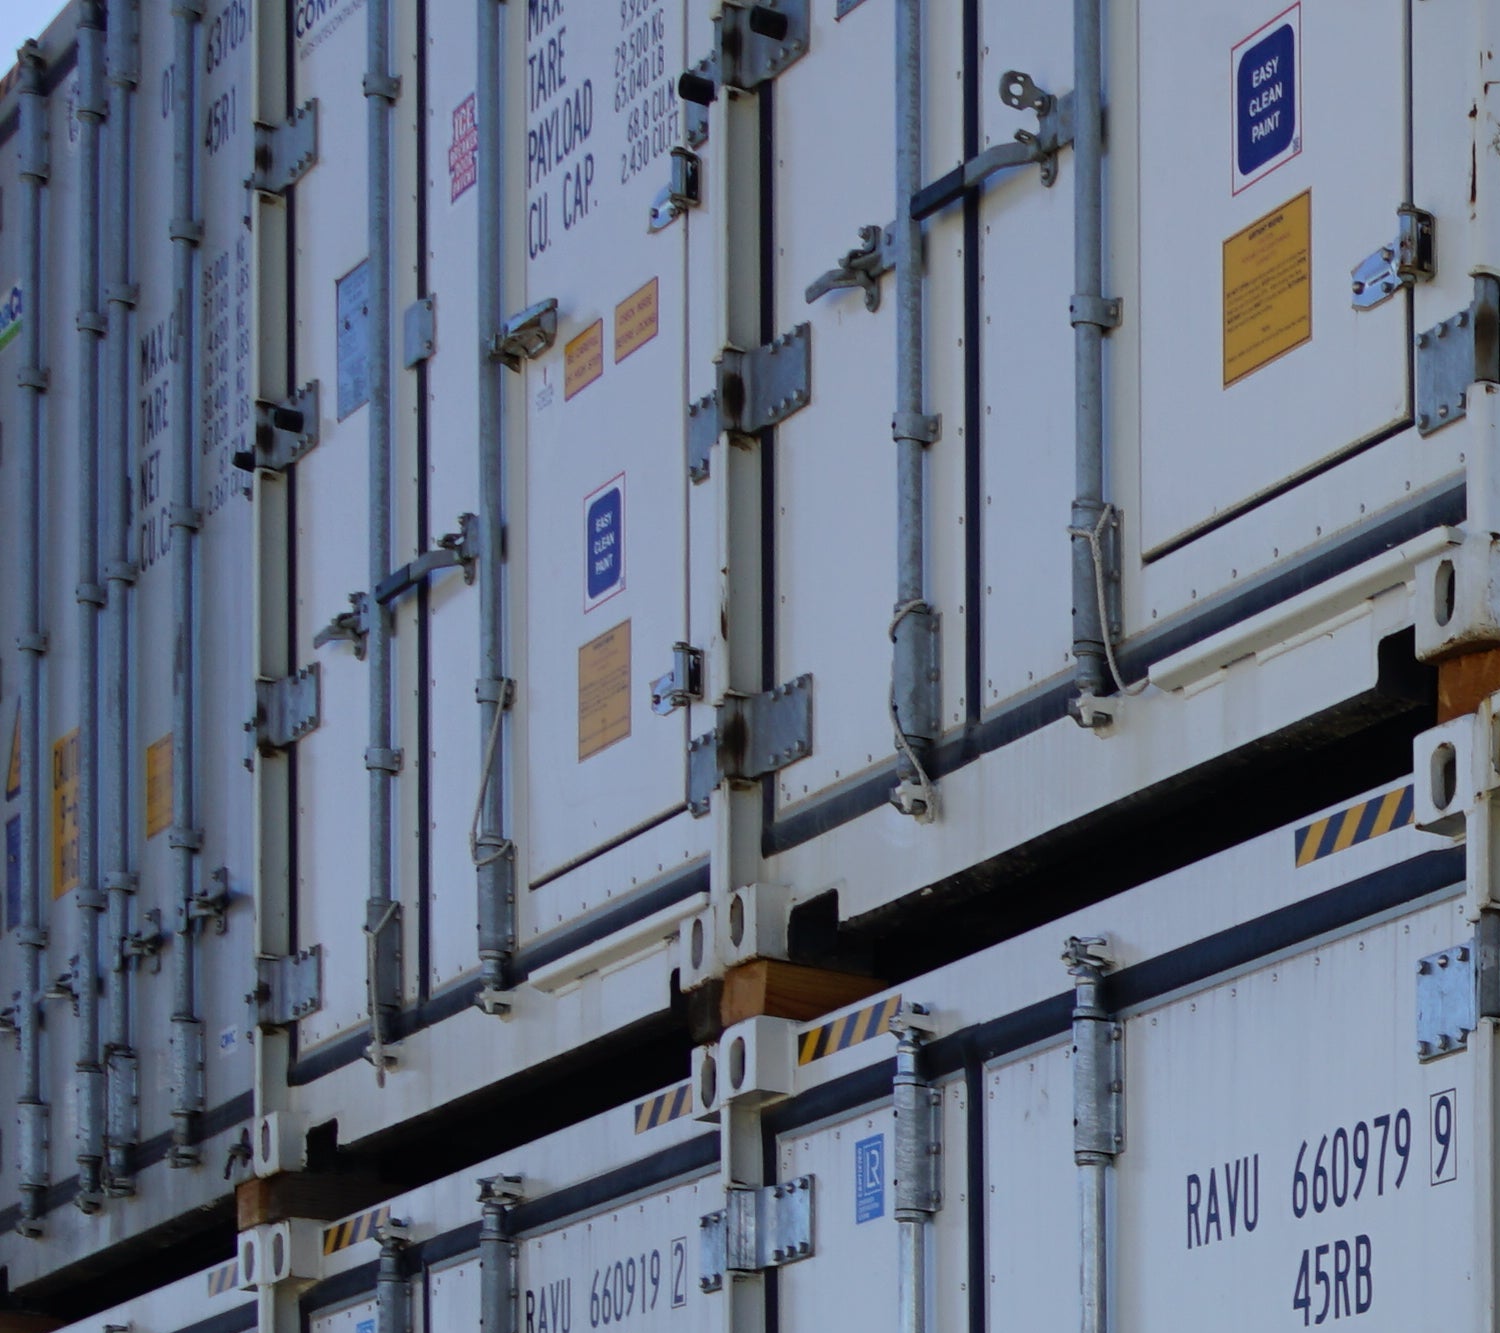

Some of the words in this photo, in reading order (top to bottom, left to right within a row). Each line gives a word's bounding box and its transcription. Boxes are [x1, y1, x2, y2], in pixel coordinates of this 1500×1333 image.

[528, 26, 566, 113] TARE
[1249, 82, 1283, 117] CLEAN
[1252, 56, 1279, 88] EASY
[528, 78, 593, 189] PAYLOAD
[1252, 111, 1281, 144] PAINT
[529, 192, 551, 260] CU.
[563, 153, 598, 231] CAP.
[1187, 1153, 1259, 1249] RAVU
[1292, 1108, 1412, 1219] 660979
[1434, 1095, 1451, 1178] 9
[590, 1249, 661, 1329] 660919
[674, 1242, 684, 1305] 2
[1293, 1233, 1372, 1327] 45RB
